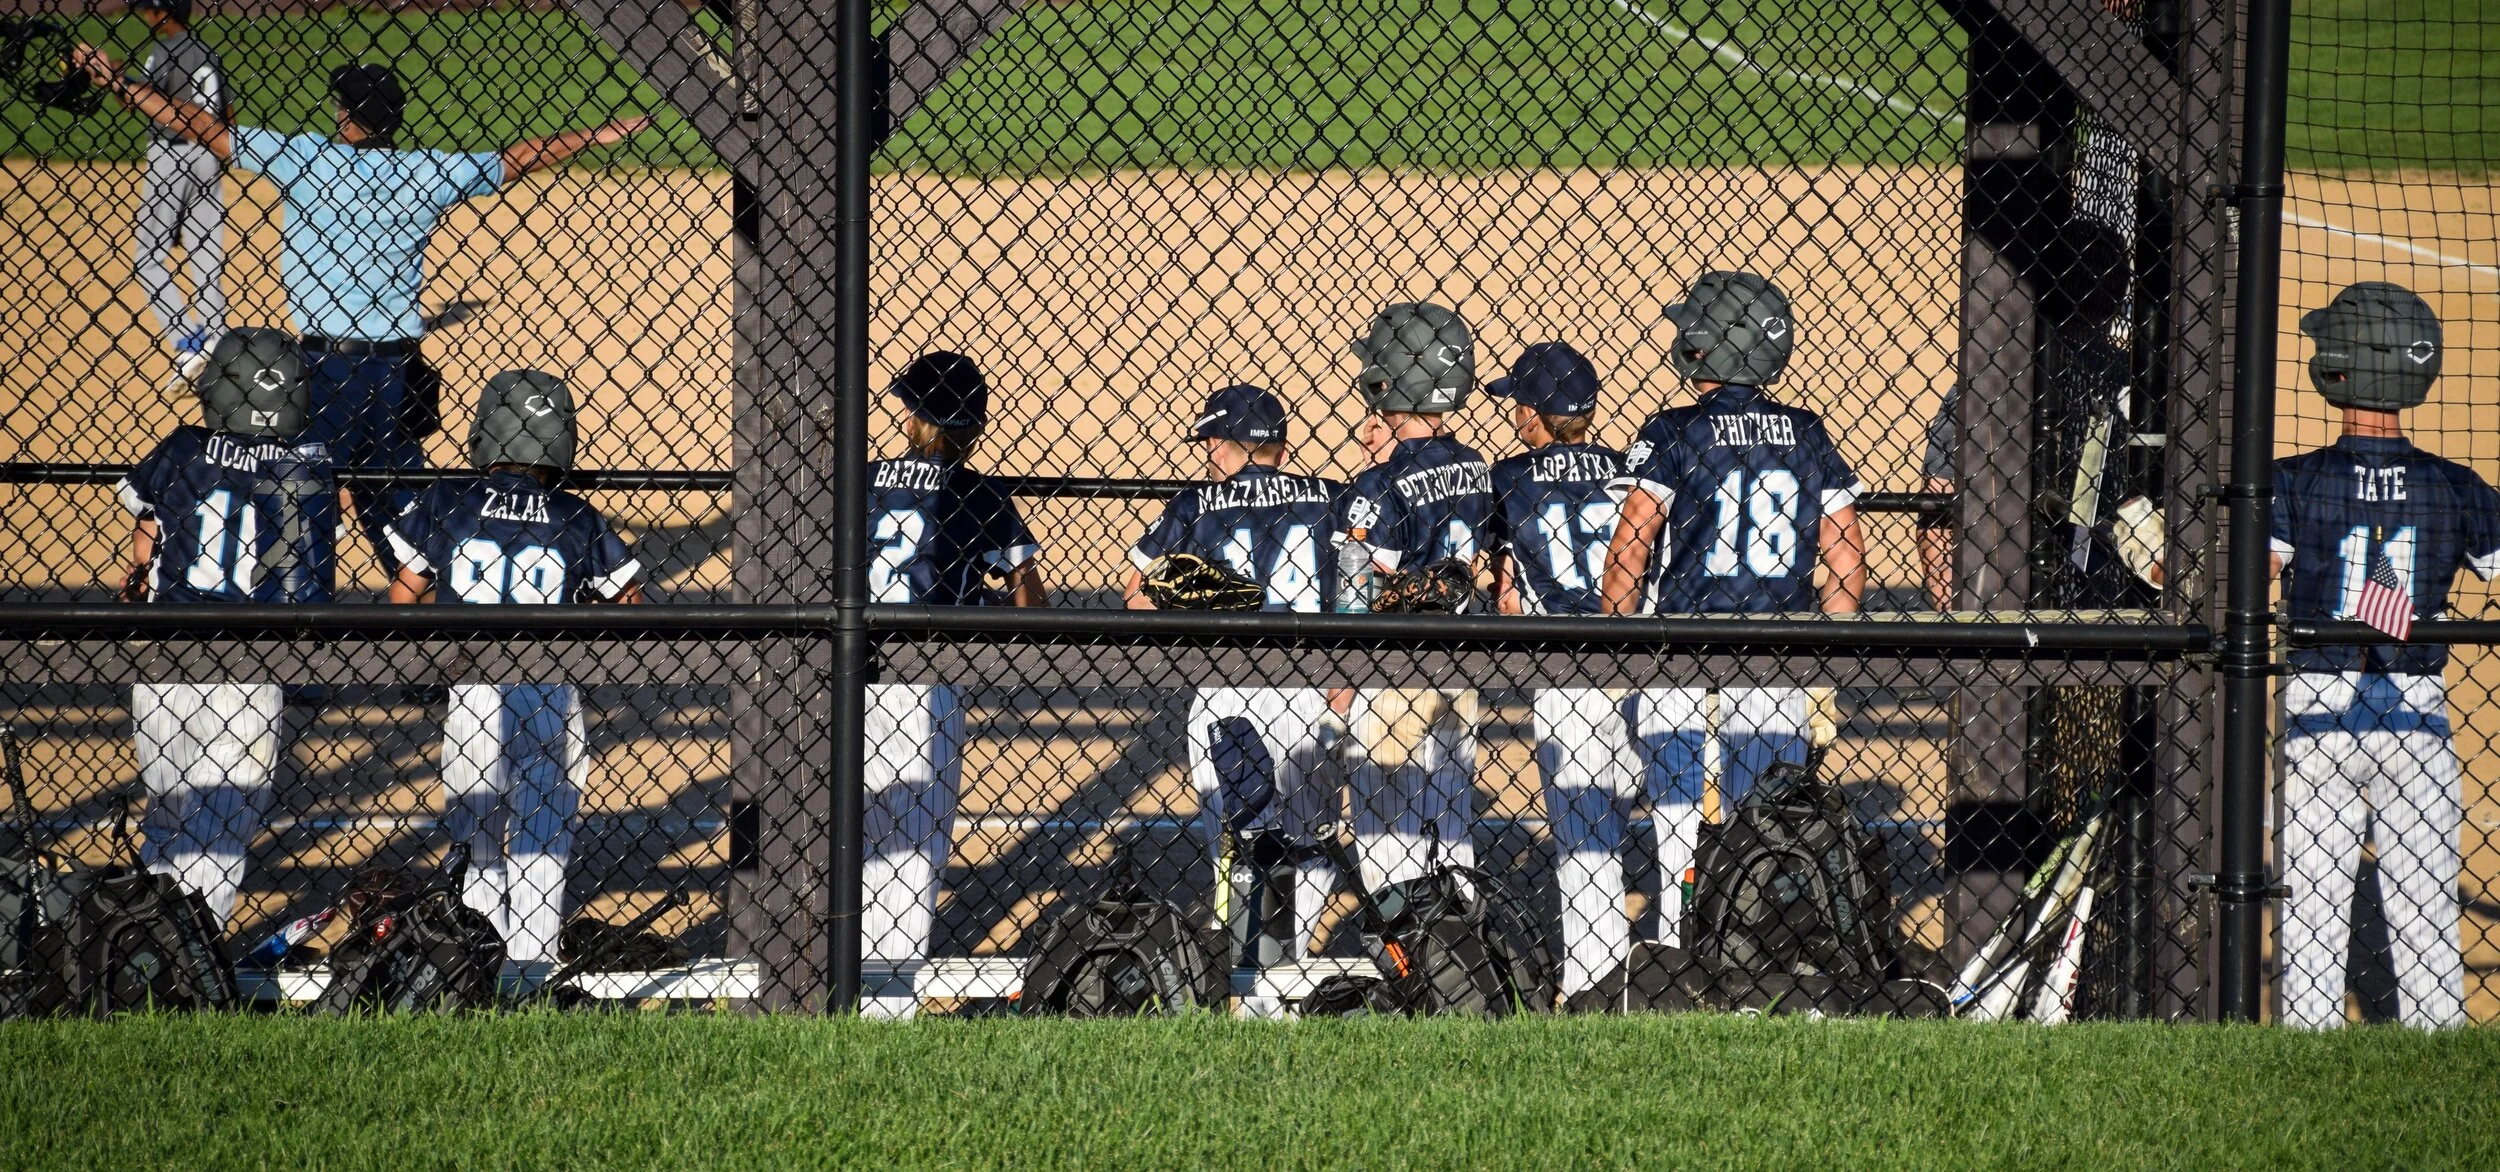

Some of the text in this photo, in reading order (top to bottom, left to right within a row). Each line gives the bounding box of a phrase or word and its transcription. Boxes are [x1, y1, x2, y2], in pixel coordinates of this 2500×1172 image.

[1568, 399, 1594, 411] IMACT
[1250, 429, 1279, 438] IMPAT
[1709, 412, 1797, 446] WHITMER
[1532, 451, 1618, 482] LOPATKA
[2354, 465, 2407, 501] TATE
[480, 487, 550, 524] ZALAK
[1198, 475, 1331, 514] MAZZARELLA
[1704, 470, 1800, 578] 18
[868, 509, 925, 604] 2
[1223, 524, 1322, 613] 14
[2332, 525, 2417, 621] 11
